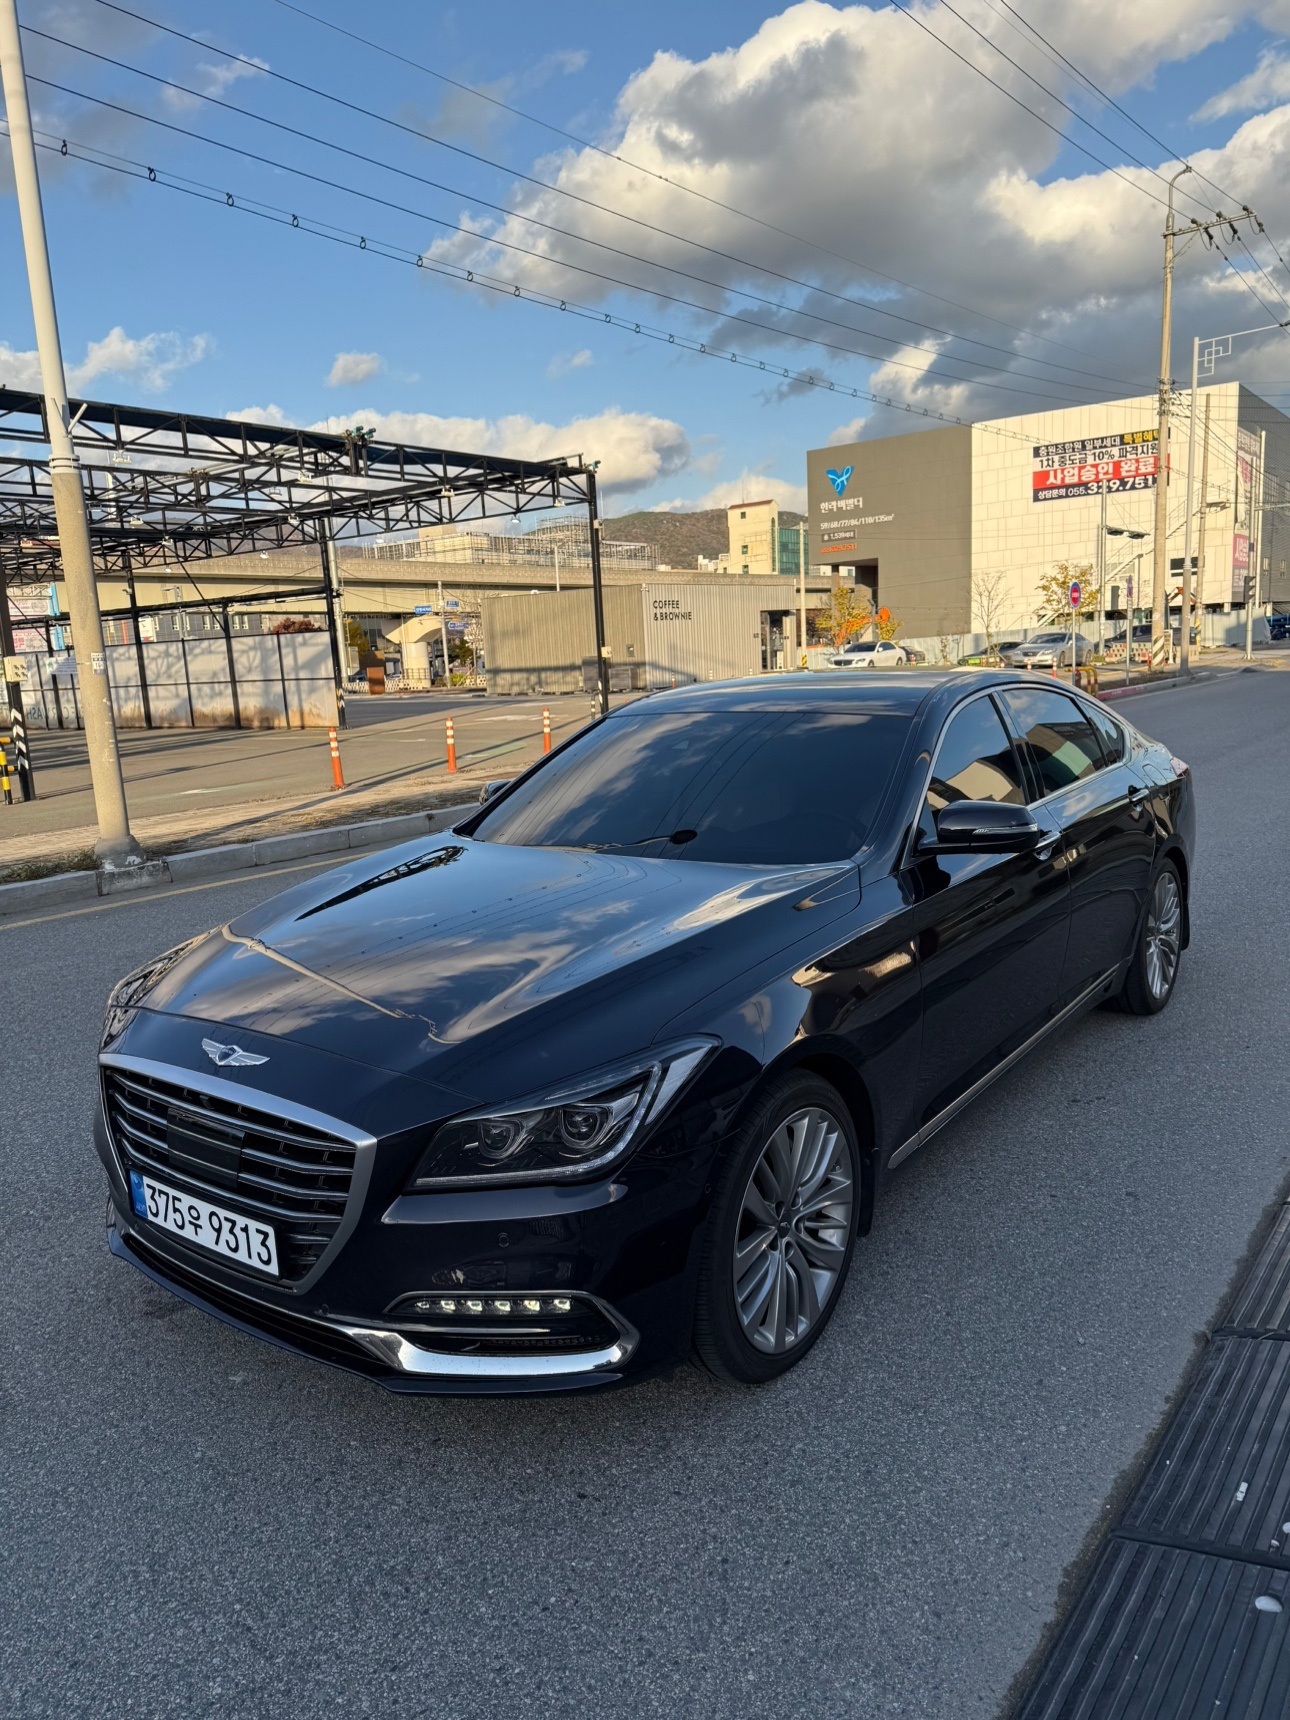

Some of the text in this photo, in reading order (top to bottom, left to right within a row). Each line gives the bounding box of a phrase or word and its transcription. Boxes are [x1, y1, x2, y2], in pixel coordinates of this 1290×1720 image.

[1084, 435, 1120, 450] 일부세대
[1039, 456, 1055, 469] 1차
[1057, 451, 1088, 466] 중도금
[1092, 449, 1115, 462] 10%
[1046, 453, 1156, 485] 사업승인 완료
[653, 600, 680, 610] COFFEE
[654, 611, 692, 621] & BROWNIE
[145, 1183, 273, 1267] 375우 9313
